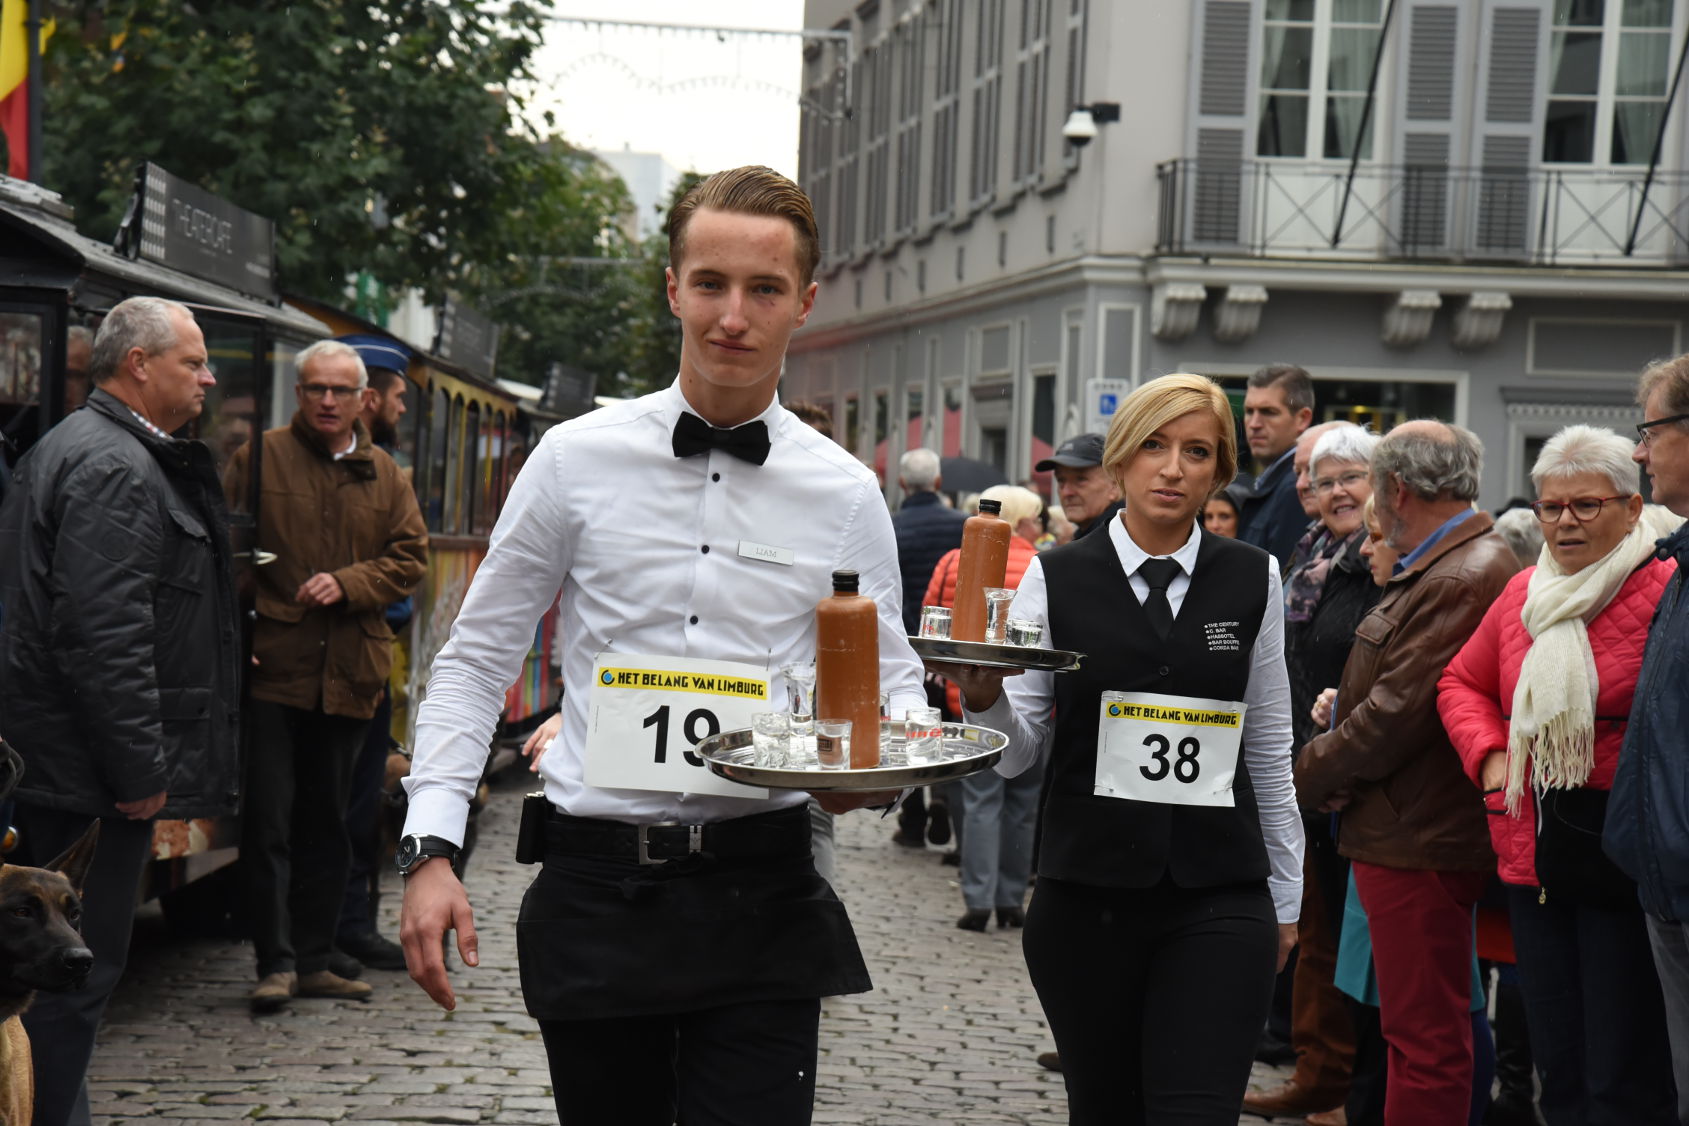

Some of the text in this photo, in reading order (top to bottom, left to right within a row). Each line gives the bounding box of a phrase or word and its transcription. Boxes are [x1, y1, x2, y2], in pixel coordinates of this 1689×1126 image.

[755, 547, 777, 558] LIAM
[618, 672, 764, 696] HET BELANG VAN LIMBURG
[1123, 705, 1237, 725] HET BELANG VAN LIMBURG
[643, 705, 720, 767] 19
[1139, 733, 1201, 784] 38
